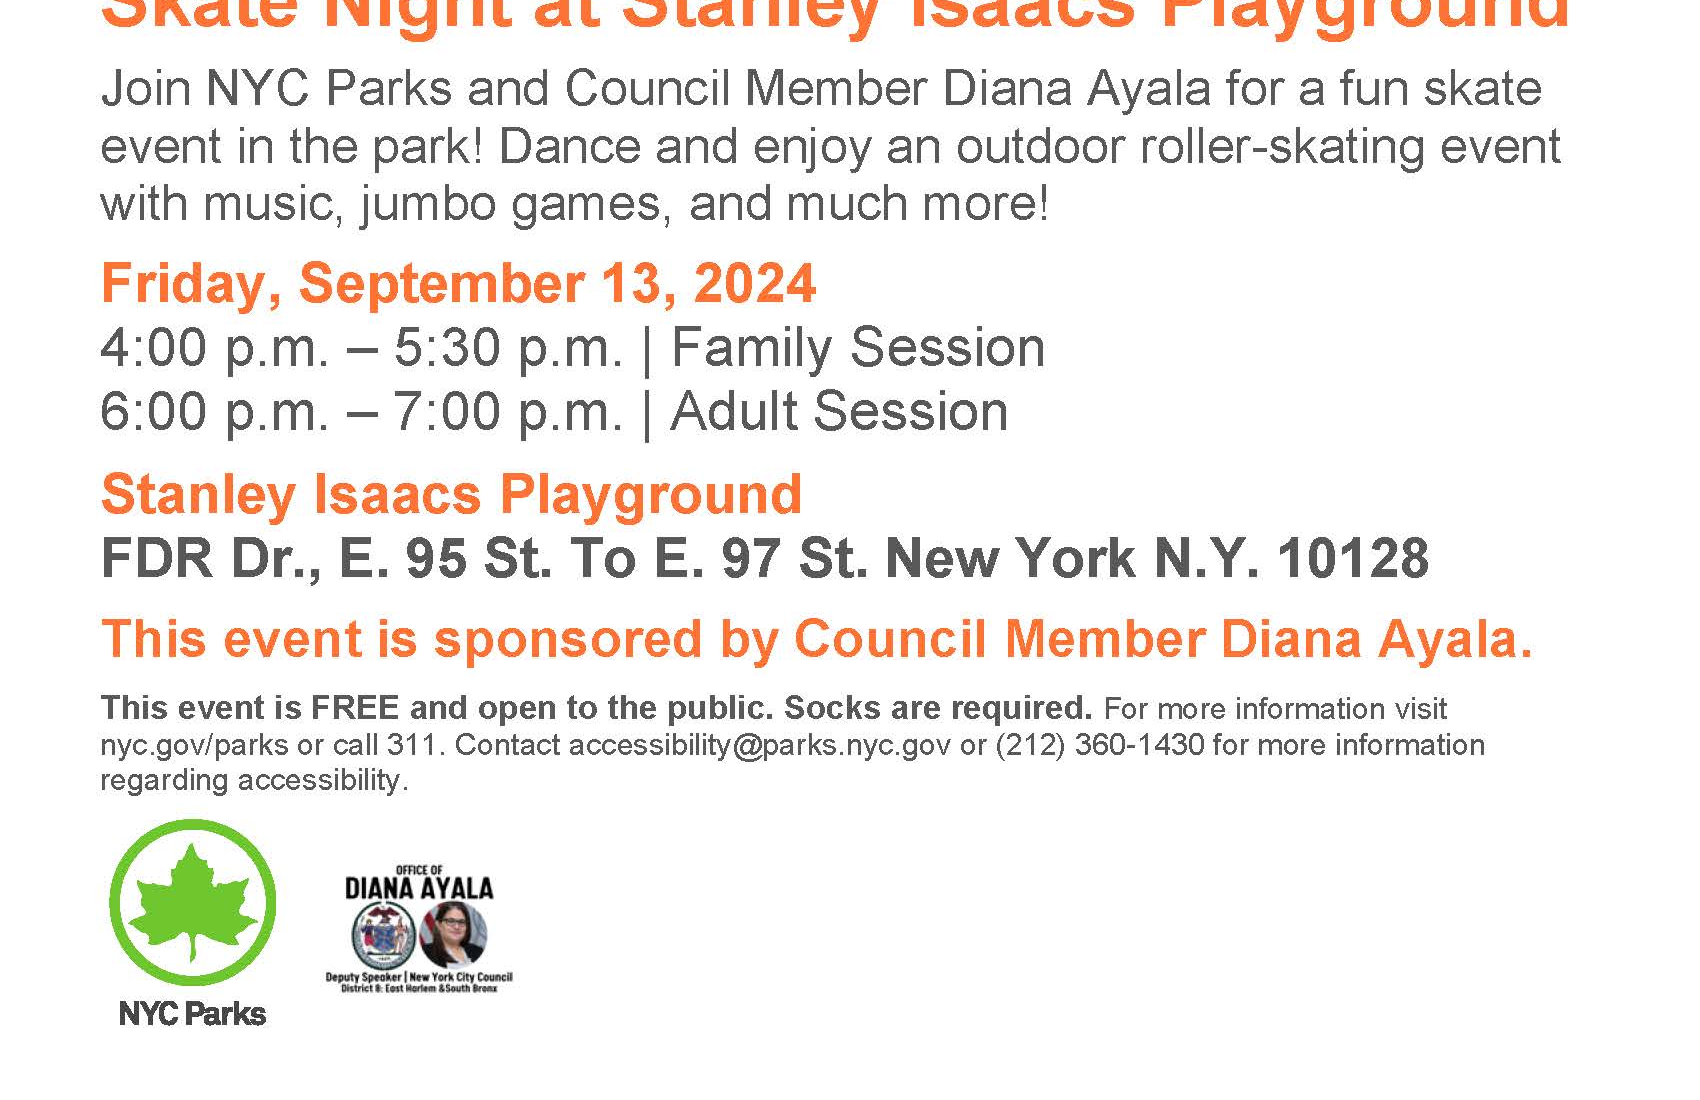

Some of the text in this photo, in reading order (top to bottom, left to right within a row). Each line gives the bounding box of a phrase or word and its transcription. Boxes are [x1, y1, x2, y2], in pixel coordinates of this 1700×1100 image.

[101, 67, 1542, 116] Join NYC Parks and Council Member Diana Ayala for a fun skate
[101, 126, 1562, 174] event in the park! Dance and enjoy an outdoor roller-skating event
[99, 183, 1047, 231] with music, jumbo games, and much more!
[103, 260, 817, 315] Friday, September 13, 2024
[100, 326, 206, 367] 4:00
[227, 335, 327, 378] p.m.
[395, 326, 500, 367] 5:30
[520, 335, 621, 378] p.m.
[674, 325, 833, 378] Family
[851, 324, 1044, 368] Session
[101, 390, 206, 431] 6:00
[227, 399, 327, 442] p.m.
[394, 390, 500, 431] 7:00
[520, 399, 621, 442] p.m.
[669, 389, 799, 431] Adult
[814, 388, 1007, 432] Session
[101, 471, 801, 526] Stanley Isaacs Playground
[103, 535, 1429, 587] FDR Dr., E. 95 St. To E. 97 St. New York N.Y. 10128
[101, 617, 1531, 669] This event is sponsored by Council Member Diana Ayala.
[100, 694, 1448, 727] This event is FREE and open to the public. Socks are required. For more information visit
[101, 732, 1485, 763] nyc.gov/parks or call 311. Contact accessibility@parks.nyc.gov or (212) 360-1430 for more information
[101, 767, 408, 797] regarding accessibility.
[345, 876, 494, 900] DIANA AYALA
[396, 864, 443, 876] OFFICE OF
[325, 972, 360, 983] Deputy
[361, 972, 402, 983] Speaker
[409, 972, 430, 983] New
[431, 972, 455, 983] York
[456, 972, 475, 983] City
[477, 972, 514, 983] Council
[341, 984, 374, 993] District
[385, 984, 405, 993] East
[405, 984, 437, 993] Harlem
[472, 984, 498, 993] Bronx
[119, 1000, 267, 1027] NYC Parks
